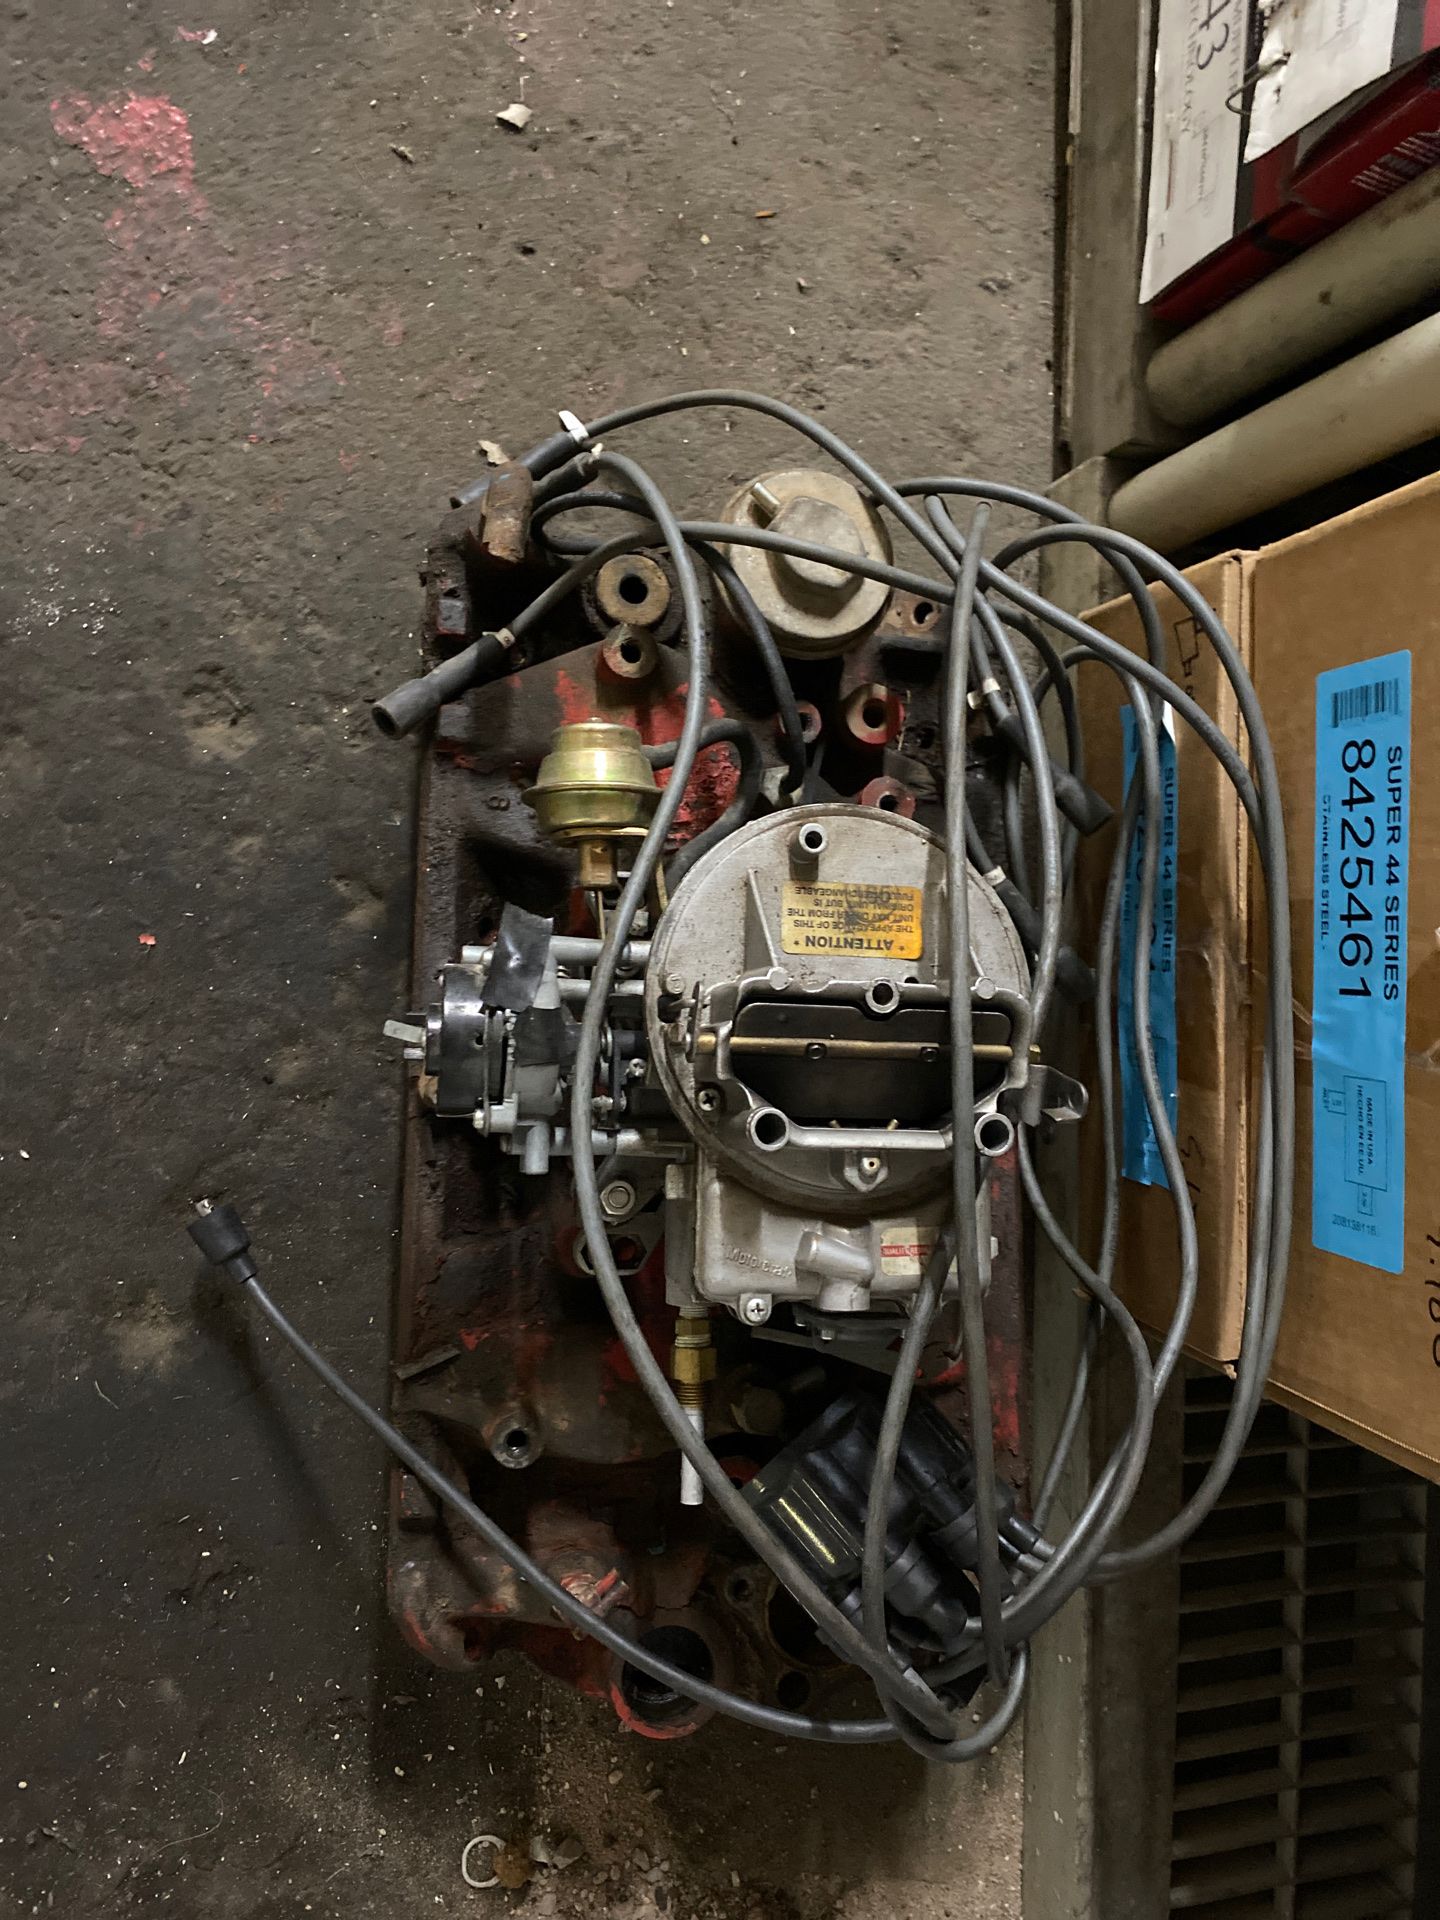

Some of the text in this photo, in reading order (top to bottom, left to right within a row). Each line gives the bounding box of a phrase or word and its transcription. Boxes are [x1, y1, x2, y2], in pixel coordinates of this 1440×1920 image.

[1161, 766, 1175, 973] SUPER 44 SERIES
[1338, 739, 1376, 998] 8425461
[1383, 745, 1404, 1000] SUPER 44 SERIES
[814, 898, 823, 907] IS
[825, 899, 843, 908] BUT
[787, 908, 806, 917] THE
[808, 909, 835, 918] FROM
[1321, 889, 1329, 940] STEEL
[793, 919, 815, 929] THIS
[817, 920, 830, 929] OF
[895, 924, 914, 933] THE
[805, 935, 895, 951] ATTENTION
[1358, 1124, 1365, 1139] EN
[1367, 1129, 1373, 1141] IN
